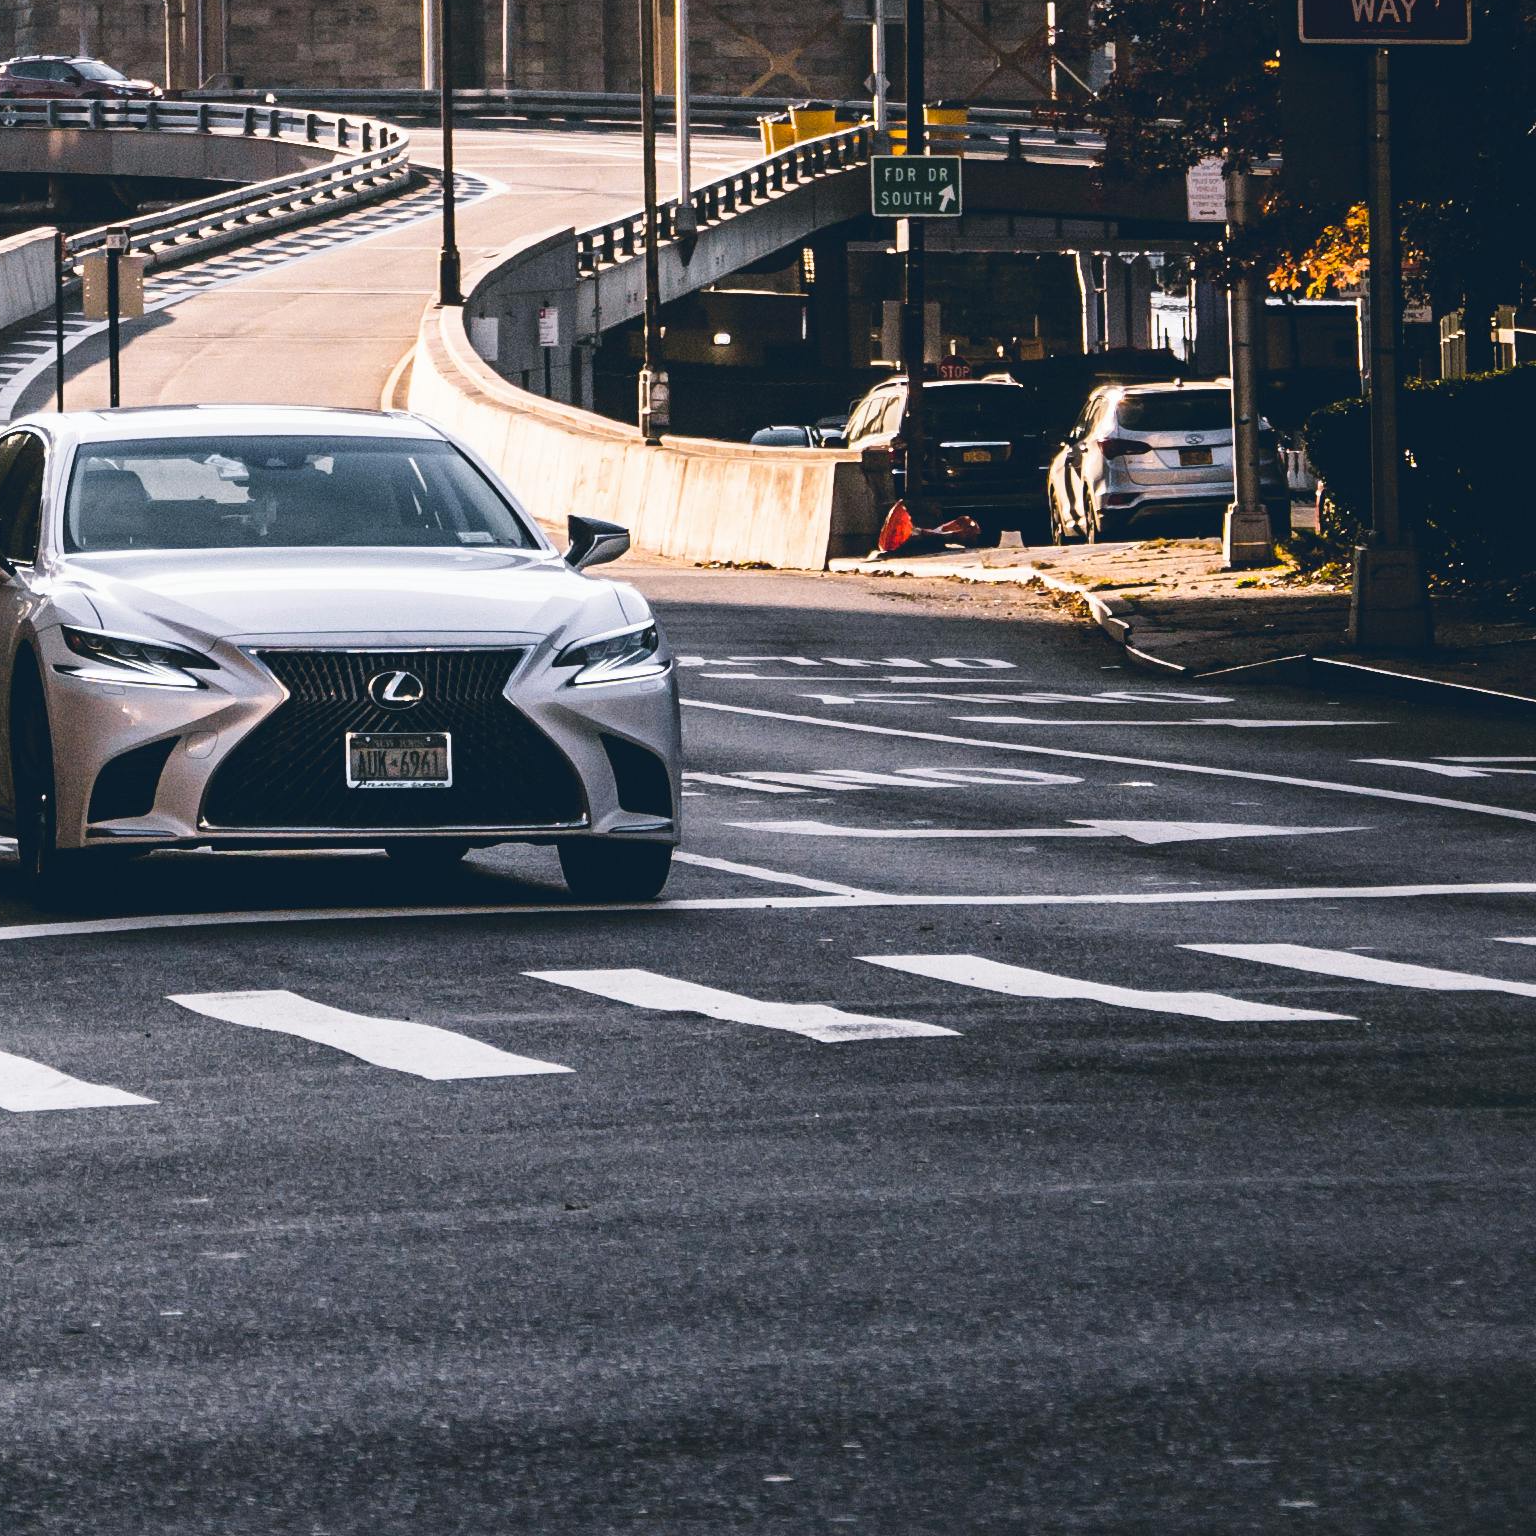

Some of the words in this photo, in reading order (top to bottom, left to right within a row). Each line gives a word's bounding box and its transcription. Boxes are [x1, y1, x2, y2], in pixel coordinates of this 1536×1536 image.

[884, 167, 917, 182] FDR
[928, 167, 948, 182] DR
[880, 191, 933, 206] SOUTH
[940, 365, 970, 378] STOP
[797, 691, 1236, 705] ONLY
[681, 767, 1086, 794] ONL
